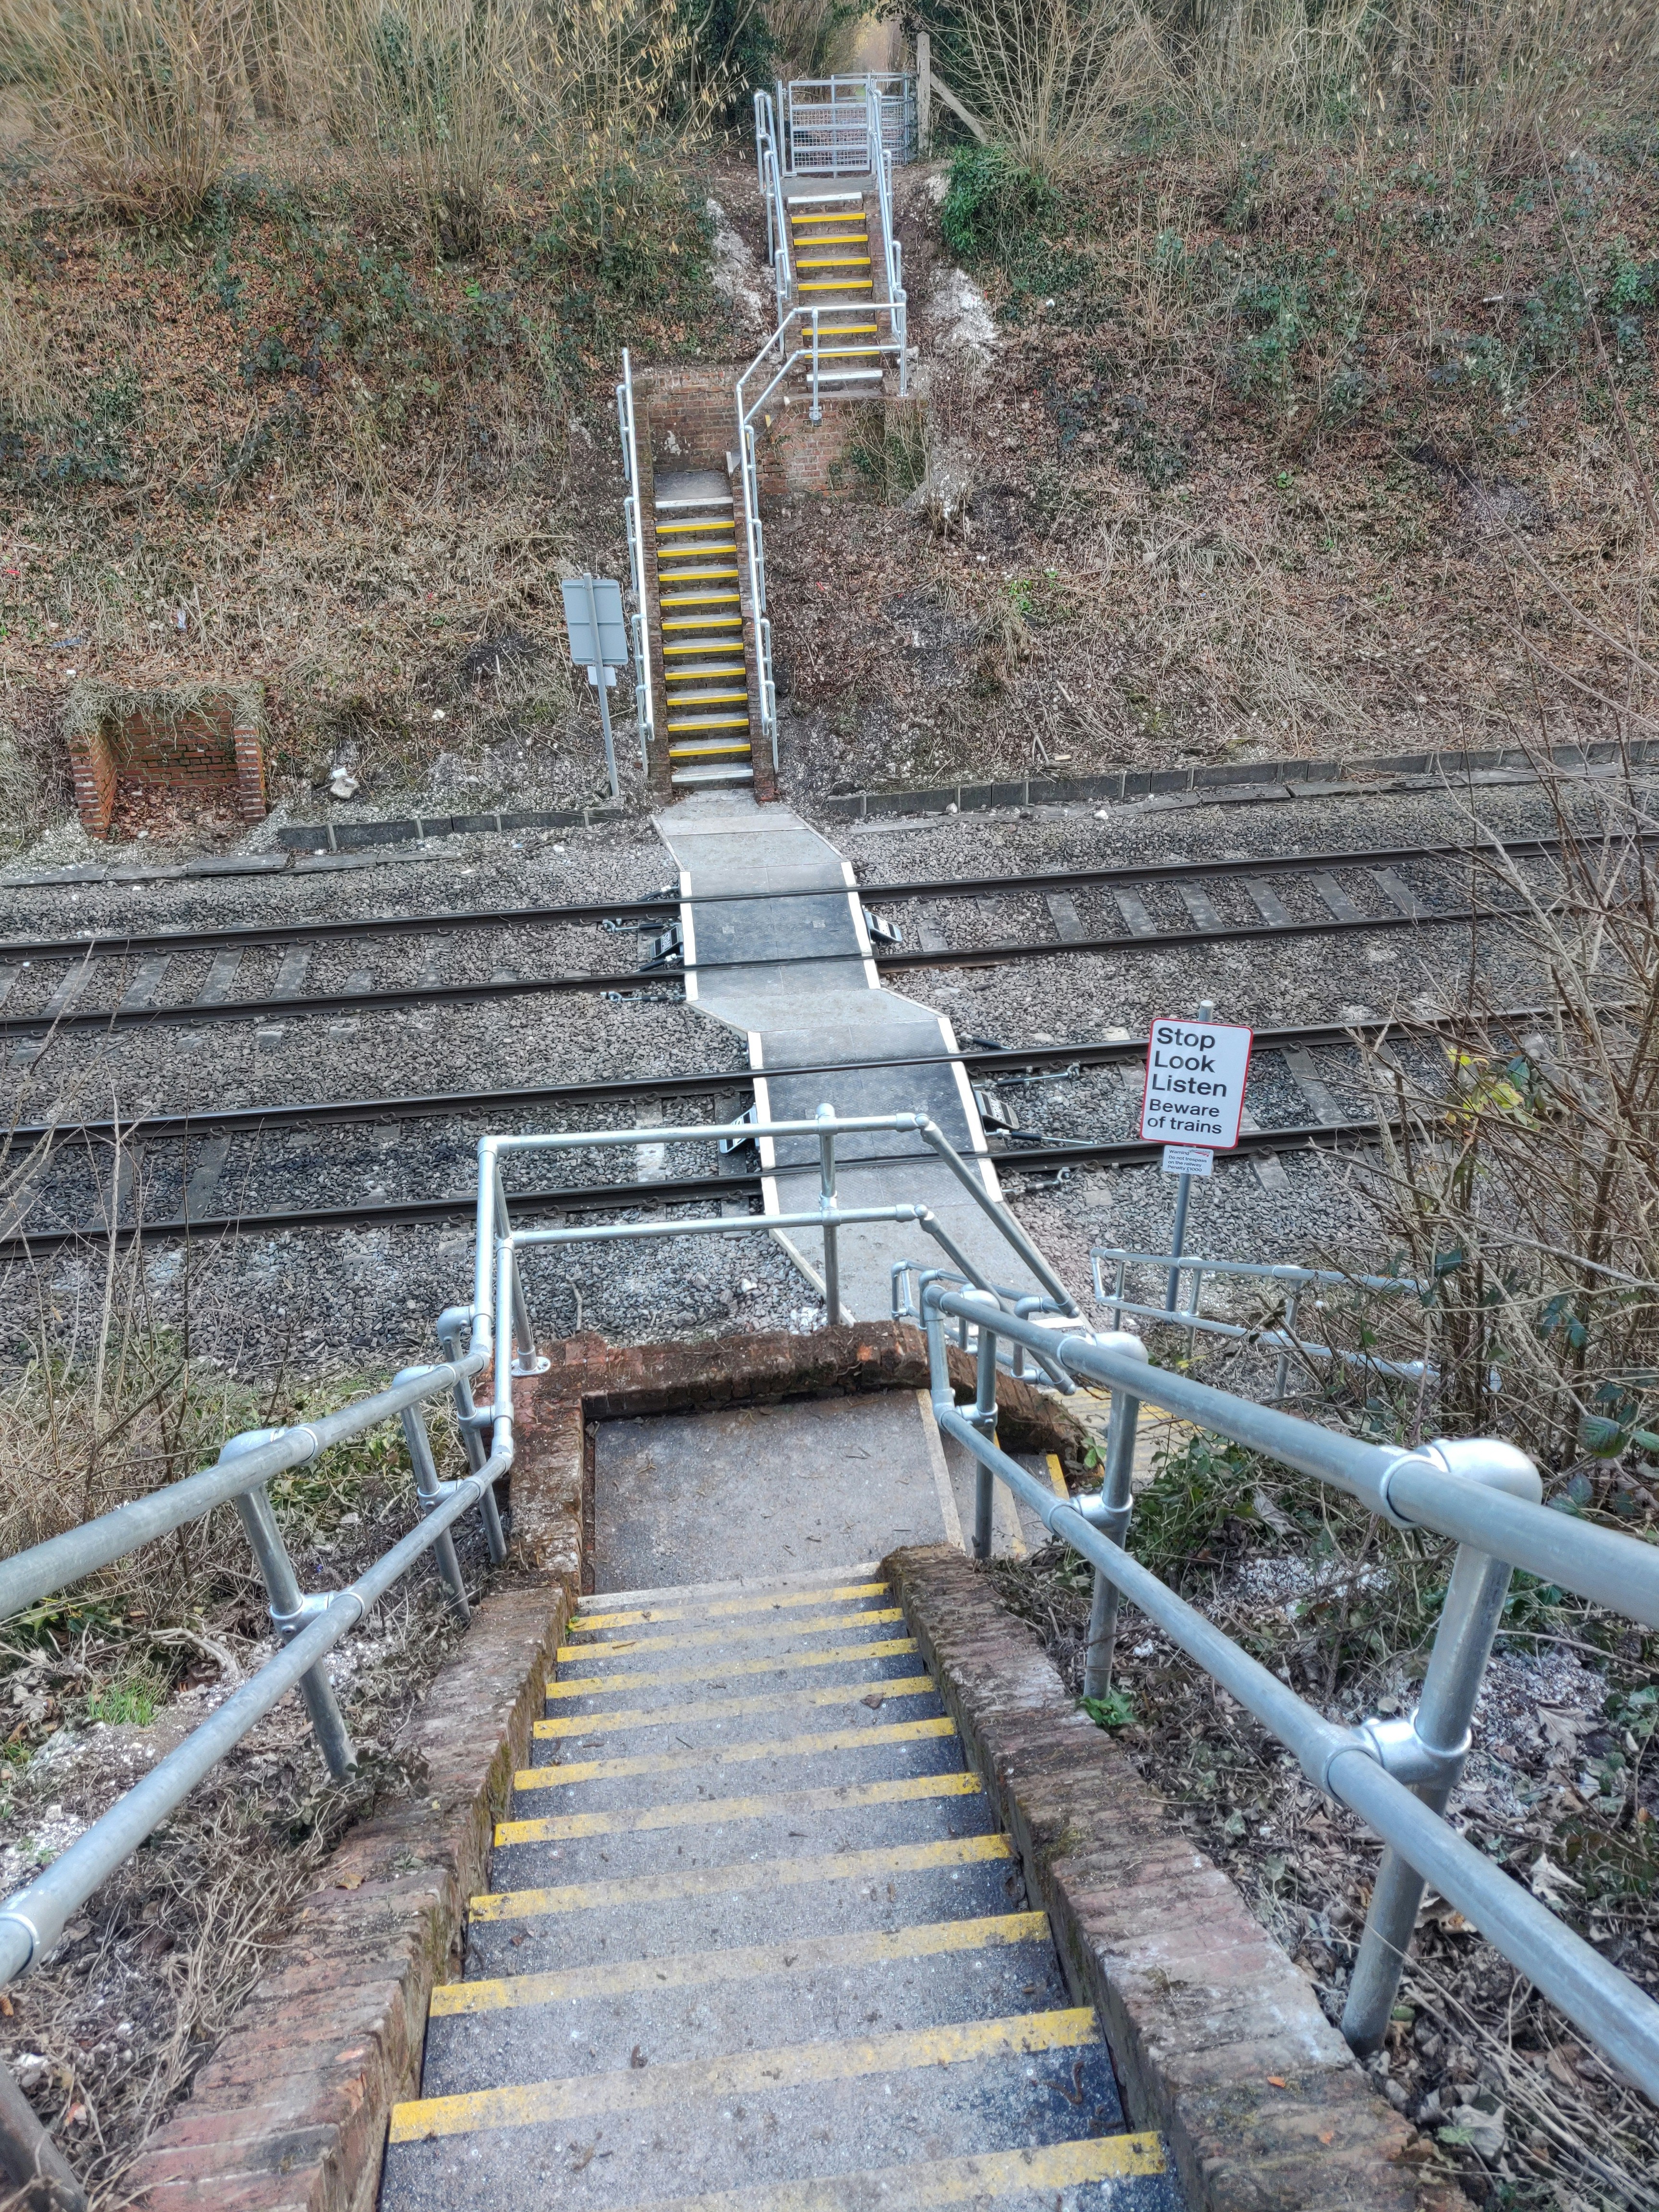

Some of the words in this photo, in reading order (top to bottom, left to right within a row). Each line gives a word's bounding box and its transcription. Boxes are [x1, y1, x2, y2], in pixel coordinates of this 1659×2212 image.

[1157, 1027, 1215, 1052] Stop
[1154, 1050, 1216, 1073] Look
[1152, 1073, 1227, 1097] Listen
[1149, 1098, 1220, 1117] Beware
[1147, 1116, 1166, 1128] of
[1170, 1117, 1222, 1134] trains
